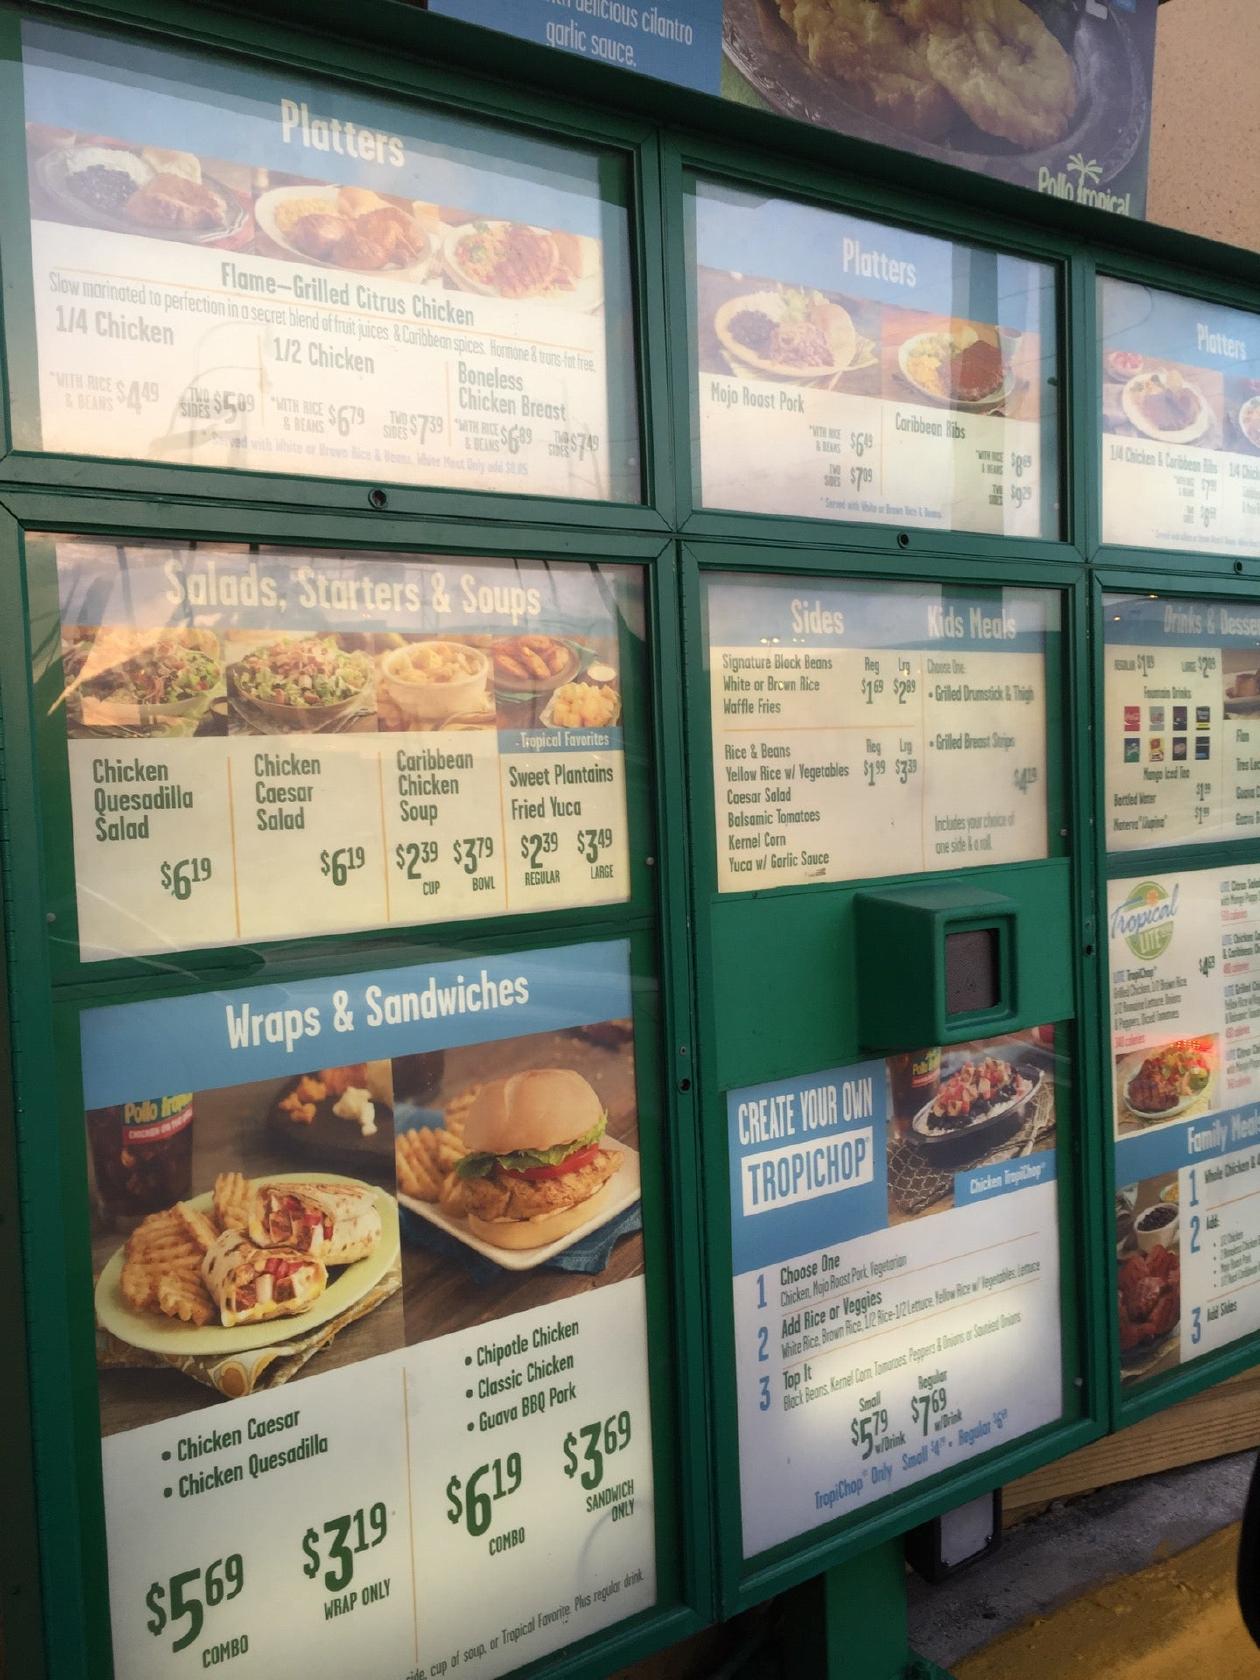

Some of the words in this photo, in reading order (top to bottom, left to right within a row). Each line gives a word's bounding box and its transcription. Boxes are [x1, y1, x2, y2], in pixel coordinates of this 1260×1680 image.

[642, 8, 693, 45] cilantro
[546, 20, 586, 51] garlic
[591, 35, 637, 66] sauce.
[280, 98, 405, 169] Platters
[842, 236, 917, 288] Platters
[50, 272, 79, 294] Slow
[82, 281, 146, 305] marinated
[149, 288, 161, 306] to
[164, 291, 225, 317] perfection
[227, 300, 239, 318] in
[251, 305, 286, 325] secret
[289, 309, 318, 330] blend
[402, 325, 451, 347] Caribbean
[356, 285, 406, 314] Citrus
[412, 294, 474, 326] Chicken
[55, 304, 88, 334] 1/4
[95, 310, 174, 345] Chicken
[274, 337, 301, 364] 1/2
[308, 341, 375, 374] Chicken
[1196, 322, 1247, 361] Platters
[458, 361, 523, 392] Boneless
[459, 387, 516, 415] Chicken
[522, 395, 566, 422] Breast
[711, 382, 738, 408] Mojo
[743, 386, 775, 410] Roast
[780, 391, 804, 413] Pork
[896, 411, 943, 437] Caribbean
[946, 420, 966, 439] Ribs
[164, 562, 286, 613] Salads,
[297, 566, 419, 614] Starters
[431, 570, 451, 613] &
[460, 573, 541, 625] Soups
[791, 598, 845, 635] Sides
[927, 604, 964, 639] Kids
[969, 607, 1017, 640] Meals
[722, 653, 771, 673] Signature
[774, 654, 800, 670] Black
[804, 655, 833, 670] Beans
[864, 656, 880, 675] Reg
[723, 675, 751, 691] White
[754, 680, 764, 691] or
[767, 675, 796, 691] Brown
[800, 675, 820, 691] Rice
[935, 685, 962, 702] Grilled
[964, 685, 1004, 702] Drumstick
[723, 698, 754, 715] Waffle
[758, 698, 781, 714] Fries
[520, 733, 561, 751] Tropical
[565, 732, 609, 746] Favorites
[724, 744, 747, 760] Rice
[750, 744, 758, 759] &
[761, 743, 791, 759] Beans
[936, 733, 962, 750] Grilled
[964, 733, 990, 749] Breast
[93, 758, 168, 784] Chicken
[254, 753, 321, 777] Chicken
[397, 748, 473, 772] Caribbean
[509, 765, 550, 787] Sweet
[555, 763, 614, 785] Plantains
[726, 766, 757, 783] Yellow
[760, 765, 781, 781] Rice
[799, 762, 849, 782] Vegetables
[94, 785, 193, 816] Quesadilla
[255, 781, 314, 804] Caesar
[398, 773, 459, 796] Chicken
[727, 789, 761, 805] Caesar
[765, 786, 791, 803] Salad
[257, 807, 305, 831] Salad
[400, 799, 438, 826] Soup
[511, 798, 545, 820] Fried
[551, 796, 582, 818] Yuca
[728, 811, 773, 828] Balsamic
[776, 808, 820, 825] Tomatoes
[935, 814, 966, 832] Includes
[96, 815, 149, 841] Salad
[728, 833, 761, 850] Kernel
[764, 831, 786, 847] Corn
[590, 865, 614, 880] LARGE
[729, 856, 753, 872] Yuca
[771, 853, 798, 868] Garlic
[801, 850, 830, 866] Sauce
[422, 880, 440, 895] CUP
[472, 876, 496, 891] BOWL
[524, 869, 560, 886] REGULAR
[1110, 882, 1180, 940] Tropical
[226, 1001, 321, 1053] Wraps
[332, 990, 354, 1033] &
[366, 968, 529, 1028] Sandwiches
[738, 1093, 796, 1146] CREATE
[800, 1084, 838, 1132] YOUR
[842, 1078, 873, 1122] OWN
[1187, 1119, 1228, 1154] Family
[970, 1174, 1003, 1194] Chicken
[1189, 1169, 1199, 1207] 1
[1190, 1215, 1200, 1254] 2
[780, 1262, 818, 1287] Choose
[822, 1254, 840, 1273] One
[830, 1272, 851, 1289] Roast
[870, 1254, 907, 1277] Vegetarian
[756, 1273, 767, 1309] 1
[782, 1318, 801, 1339] Add
[804, 1310, 827, 1330] Rice
[830, 1305, 840, 1320] or
[843, 1290, 882, 1317] Veggies
[1191, 1306, 1201, 1345] 3
[476, 1334, 528, 1367] Chipotle
[532, 1320, 579, 1349] Chicken
[757, 1326, 769, 1362] 2
[478, 1369, 522, 1399] Classic
[527, 1354, 574, 1383] Chicken
[782, 1370, 800, 1391] Top
[804, 1363, 812, 1382] It
[859, 1391, 881, 1412] Small
[918, 1369, 947, 1391] Regular
[479, 1405, 518, 1432] Guava
[521, 1390, 546, 1417] BBQ
[550, 1382, 577, 1407] Pork
[759, 1375, 771, 1412] 3
[783, 1390, 804, 1412] Black
[177, 1427, 242, 1461] Chicken
[247, 1410, 300, 1441] Caesar
[179, 1464, 243, 1498] Chicken
[249, 1434, 328, 1478] Quesadilla
[871, 1461, 893, 1485] Only
[902, 1444, 929, 1471] Small
[958, 1420, 991, 1446] Regular
[586, 1478, 635, 1513] SANDWICH
[611, 1498, 635, 1522] ONLY
[488, 1526, 526, 1556] COMBO
[324, 1590, 358, 1621] WRAP
[362, 1578, 391, 1606] ONLY
[430, 1660, 447, 1677] cup
[502, 1616, 536, 1644] Tropical
[574, 1593, 591, 1612] Plus
[593, 1580, 621, 1602] regular
[202, 1634, 249, 1668] COMBO
